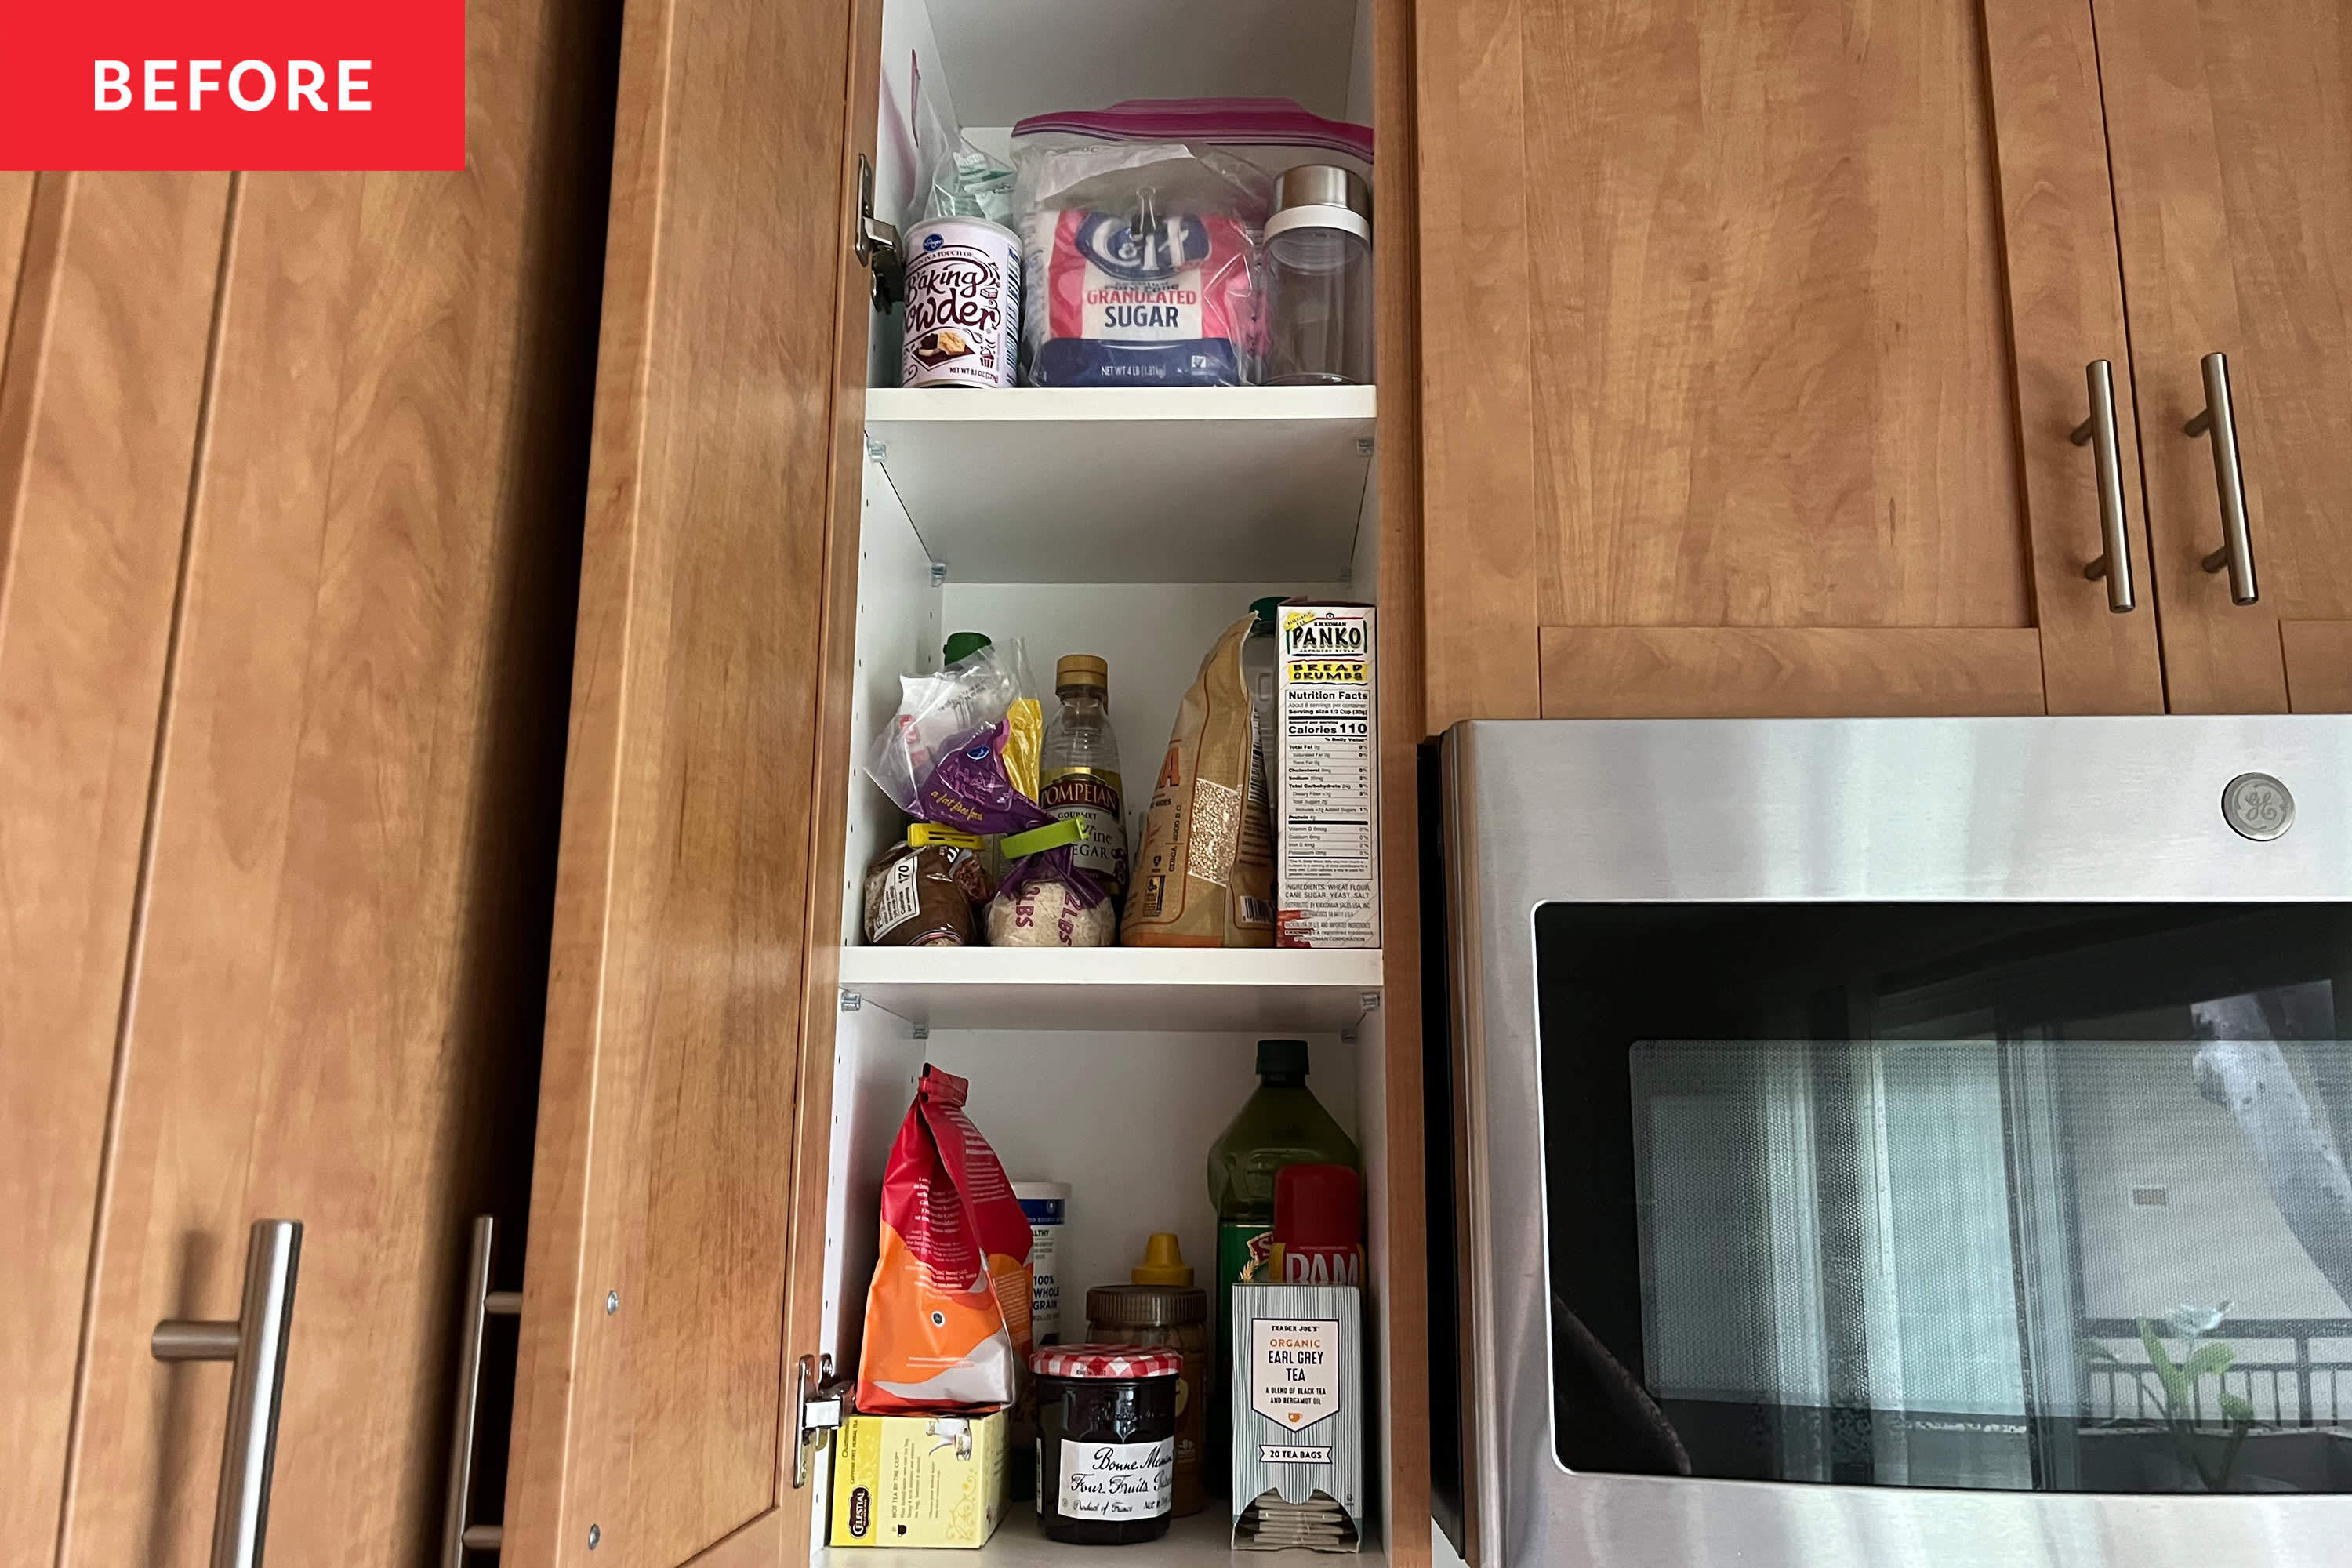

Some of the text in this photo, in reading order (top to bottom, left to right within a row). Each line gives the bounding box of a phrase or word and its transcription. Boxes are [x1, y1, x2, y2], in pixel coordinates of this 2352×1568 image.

[906, 265, 980, 307] Baking
[1087, 290, 1197, 305] GRANULATED
[903, 288, 996, 334] owder
[1105, 306, 1179, 328] SUGAR
[1101, 366, 1113, 376] NET
[1115, 366, 1126, 376] WT
[1127, 366, 1131, 376] 4
[1292, 626, 1361, 648] PANKO
[1294, 672, 1363, 681] CRUMBS
[1339, 691, 1367, 700] Facts
[1340, 723, 1367, 734] 110
[1041, 783, 1116, 811] POMPEIAN
[1073, 844, 1109, 859] EGAR
[1168, 846, 1178, 872] CIRCA
[898, 865, 909, 884] 170
[1033, 1275, 1054, 1286] 100%
[1033, 1286, 1060, 1298] WHOLE
[1033, 1300, 1057, 1311] GRAIN
[1270, 1339, 1320, 1348] ORGANIC
[1269, 1350, 1323, 1364] EARL GREY
[1286, 1368, 1305, 1381] TEA
[1092, 1447, 1138, 1471] Bonne
[894, 1482, 898, 1491] BY
[1071, 1473, 1105, 1493] Four
[1109, 1474, 1148, 1494] Fruits
[853, 1492, 865, 1534] CELESTIAL
[1073, 1499, 1099, 1512] Product
[1101, 1501, 1109, 1515] of
